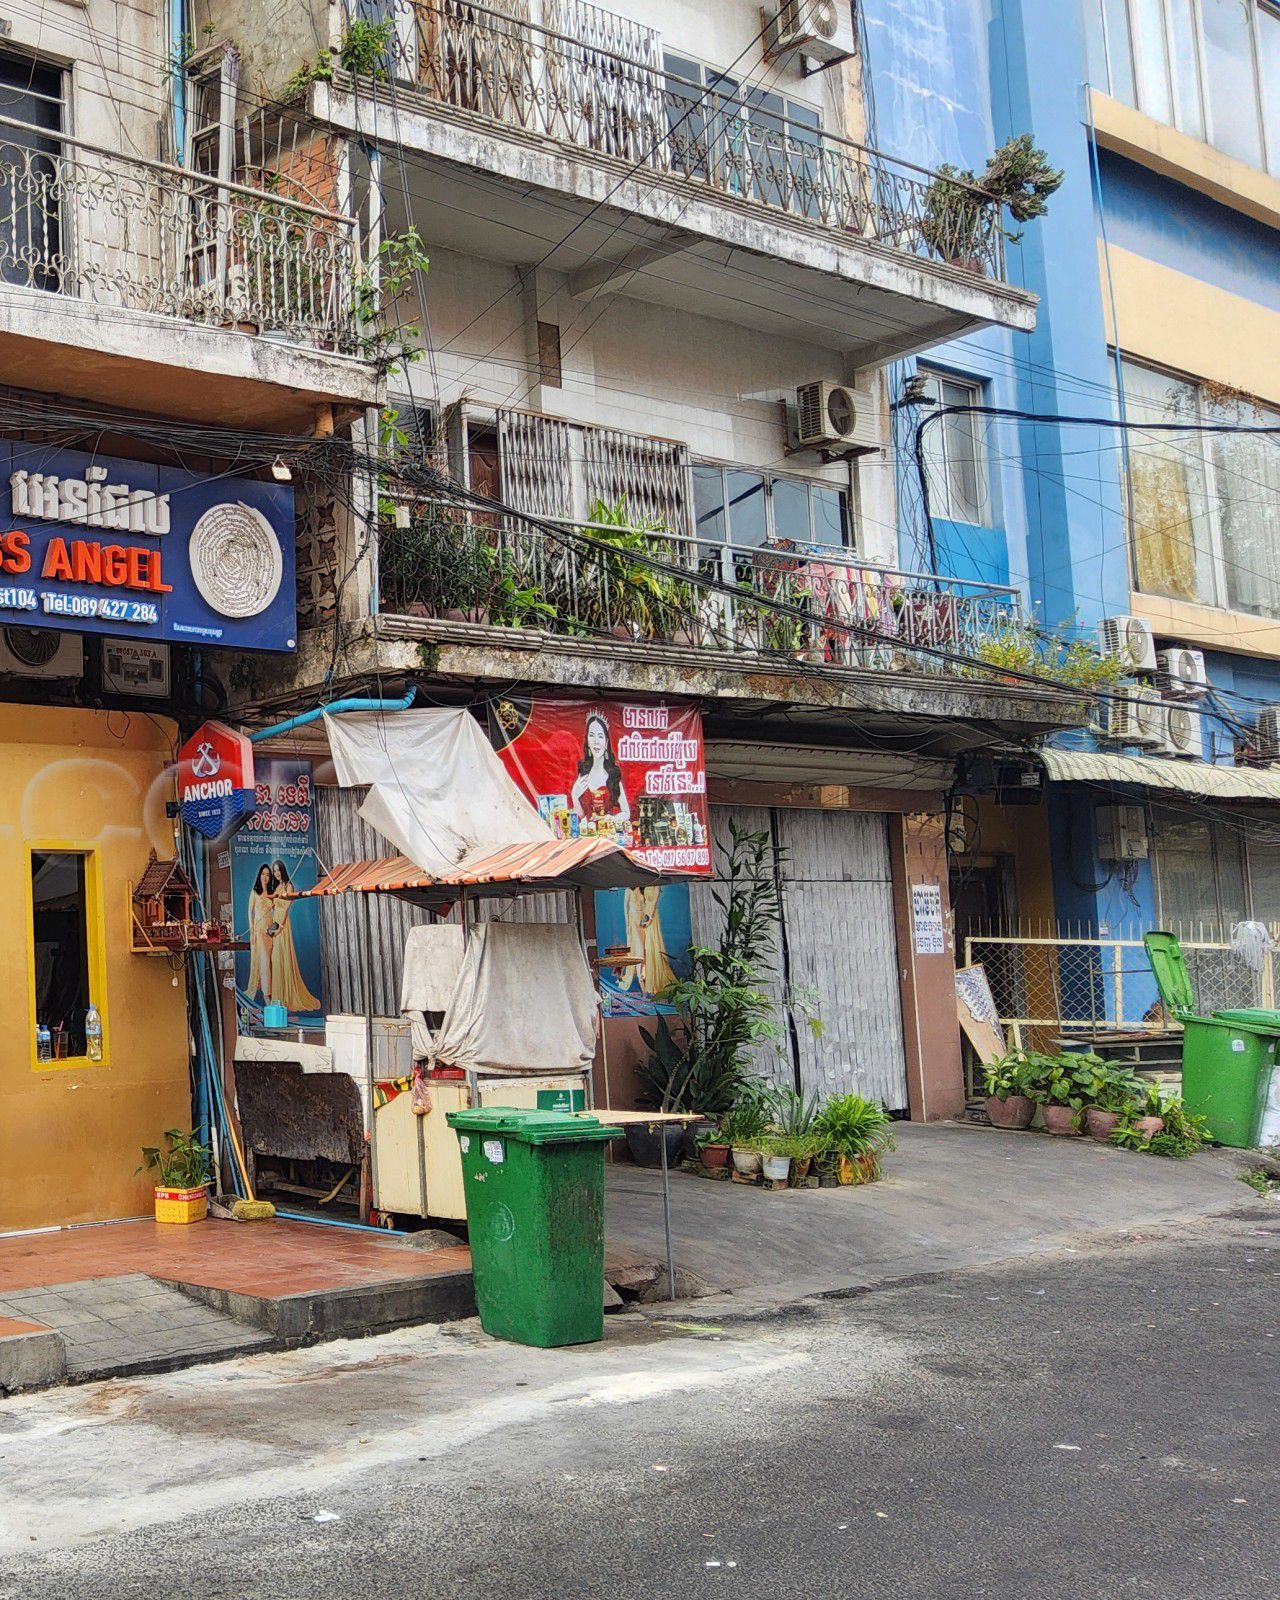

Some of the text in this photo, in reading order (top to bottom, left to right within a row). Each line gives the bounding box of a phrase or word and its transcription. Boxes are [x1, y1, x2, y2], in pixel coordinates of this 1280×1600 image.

[41, 537, 173, 594] ANGEL
[132, 603, 159, 622] 284
[183, 778, 233, 803] ANCHOR
